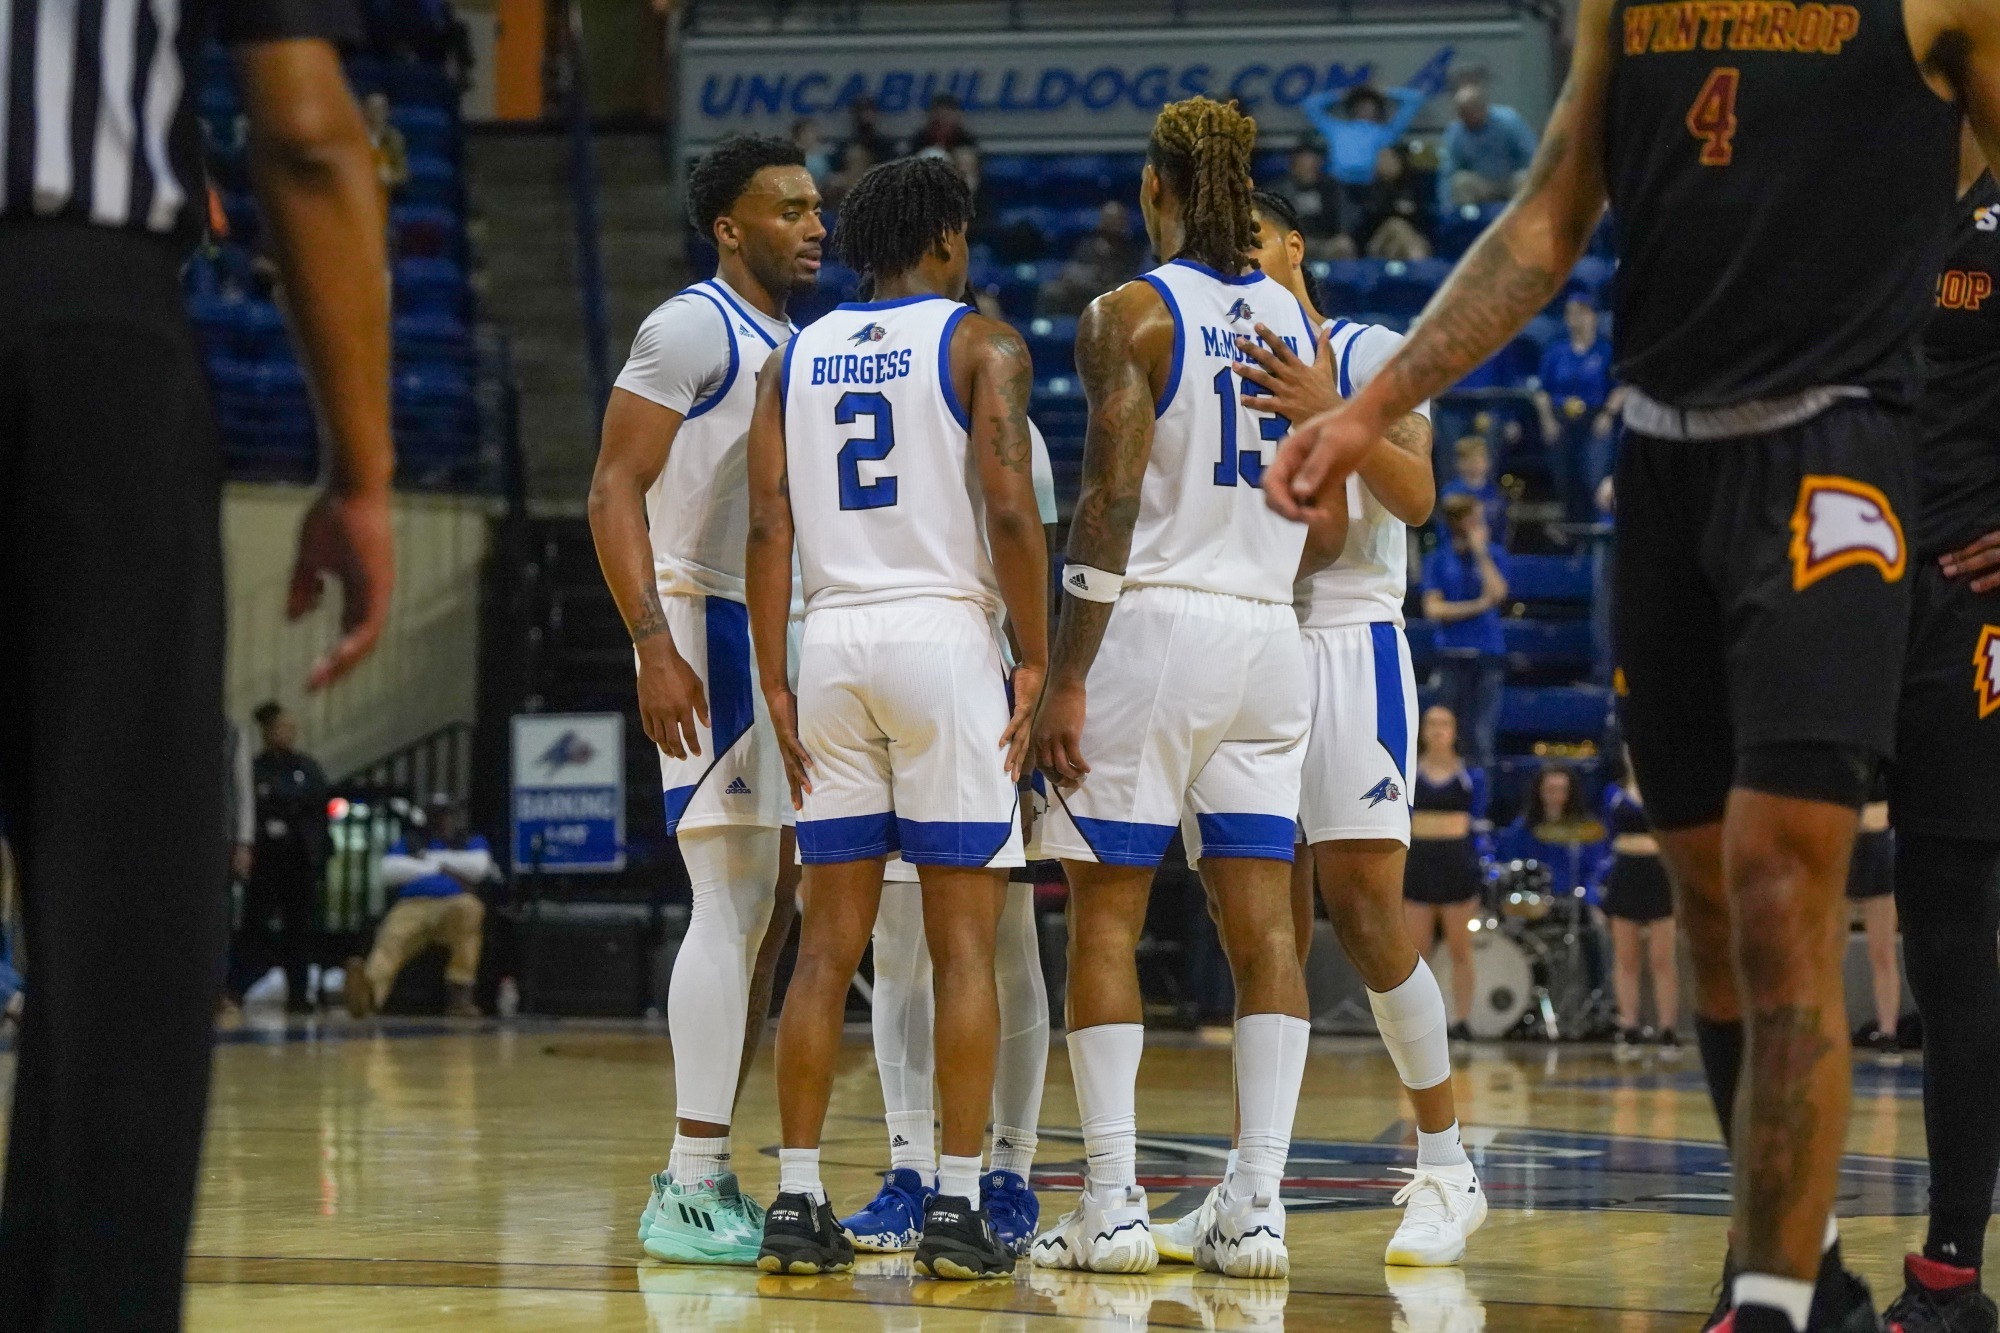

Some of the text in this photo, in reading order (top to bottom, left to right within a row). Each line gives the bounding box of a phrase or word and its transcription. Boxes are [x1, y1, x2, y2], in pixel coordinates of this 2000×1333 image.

[1624, 1, 1860, 55] WINTHROP
[700, 60, 1374, 118] UNCABULLDOGSCOM
[1686, 67, 1740, 165] 4
[1936, 271, 1992, 310] OP
[811, 348, 912, 385] BURGESS
[834, 391, 898, 511] 2
